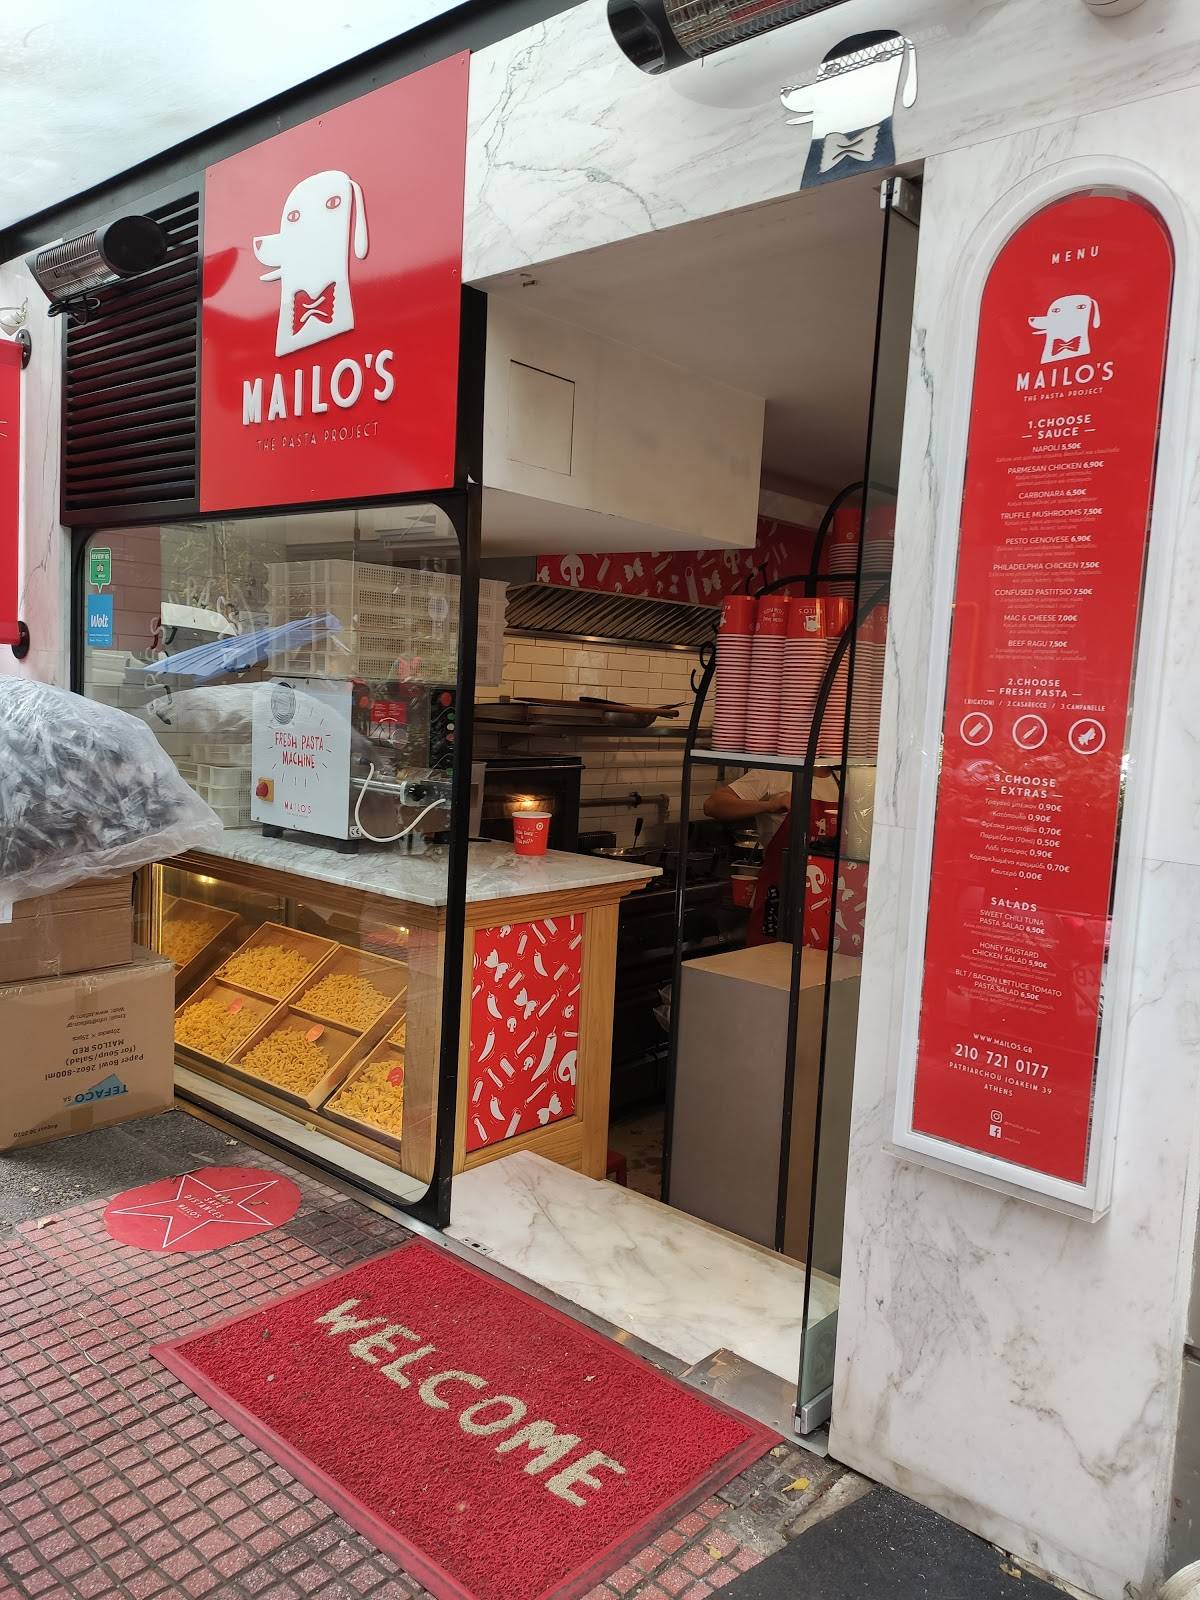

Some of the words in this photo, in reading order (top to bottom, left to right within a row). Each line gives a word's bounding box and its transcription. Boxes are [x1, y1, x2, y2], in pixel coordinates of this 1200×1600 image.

[1051, 246, 1099, 264] MENU
[1016, 362, 1114, 391] MAILO'S
[243, 350, 394, 425] MAILO'S
[1023, 394, 1037, 402] THE
[1041, 392, 1064, 400] PASTA
[1068, 387, 1103, 398] PROJECT
[1028, 414, 1092, 429] 1.CHOOSE
[256, 438, 276, 451] THE
[282, 432, 317, 448] PASTA
[324, 422, 378, 442] PROJECT
[1038, 428, 1079, 439] SAUCE
[1032, 444, 1060, 453] NAPOLI
[1008, 465, 1047, 474] PARMESAN
[1048, 462, 1082, 471] CHICKEN
[1018, 490, 1065, 499] CARBONARA
[1000, 511, 1030, 520] TRUFFLE
[1032, 509, 1082, 518] MUSHROOMS
[1006, 537, 1028, 545] PESTO
[1030, 536, 1069, 544] GENOVESE
[993, 562, 1044, 571] PHILADELPHIA
[1080, 561, 1100, 569] 7,50€
[1035, 588, 1073, 596] PASTITSIO
[91, 614, 108, 628] Wolt
[1004, 614, 1020, 622] MAC
[1021, 614, 1027, 622] &
[1048, 640, 1068, 648] 7,50€
[1008, 678, 1060, 687] 2.CHOOSE
[999, 688, 1031, 696] FRESH
[1035, 689, 1068, 698] PASTA
[275, 732, 297, 749] FRESH
[301, 734, 324, 751] PASTA
[282, 751, 315, 769] MACHINE
[993, 774, 1056, 788] 3.CHOOSE
[1000, 786, 1047, 799] EXTRAS
[1038, 802, 1062, 813] 0,90€
[1027, 813, 1052, 823] 0,90€
[1038, 826, 1062, 836] 0,70€
[1029, 848, 1053, 859] 0,90€
[1047, 863, 1070, 873] 0,70€
[1019, 871, 1043, 881] 0,00€
[991, 897, 1037, 912] SALADS
[980, 909, 1003, 919] SWEET
[1004, 913, 1024, 922] CHILI
[1025, 917, 1045, 926] TUNA
[979, 918, 1001, 926] PASTA
[1001, 921, 1024, 932] SALAD
[972, 948, 1003, 960] CHICKEN
[1004, 954, 1027, 965] SALAD
[979, 942, 1004, 951] HONEY
[1005, 947, 1039, 959] MUSTARD
[972, 972, 998, 983] BACON
[999, 977, 1030, 990] LETTUCE
[1031, 984, 1062, 997] TOMATO
[974, 981, 995, 991] PASTA
[995, 986, 1019, 996] SALAD
[91, 1039, 124, 1051] MAILOS
[121, 1044, 136, 1055] (for
[973, 1033, 1033, 1054] WWW.MAILOS.GR
[66, 1049, 119, 1066] Soup/Salad)
[72, 1047, 90, 1055] RED
[99, 1058, 119, 1070] Bowl
[121, 1054, 144, 1064] Paper
[954, 1043, 978, 1060] 210
[986, 1051, 1008, 1068] 721
[1016, 1059, 1049, 1079] 0177
[45, 1064, 96, 1080] 26oz-800ml
[949, 1062, 1002, 1081] PATRIARCHOU
[1005, 1077, 1038, 1091] IOAKEIM
[1041, 1086, 1052, 1095] 39
[75, 1084, 129, 1103] TEFACO
[984, 1083, 1013, 1097] ATHENS
[314, 1298, 627, 1508] WELCOME
